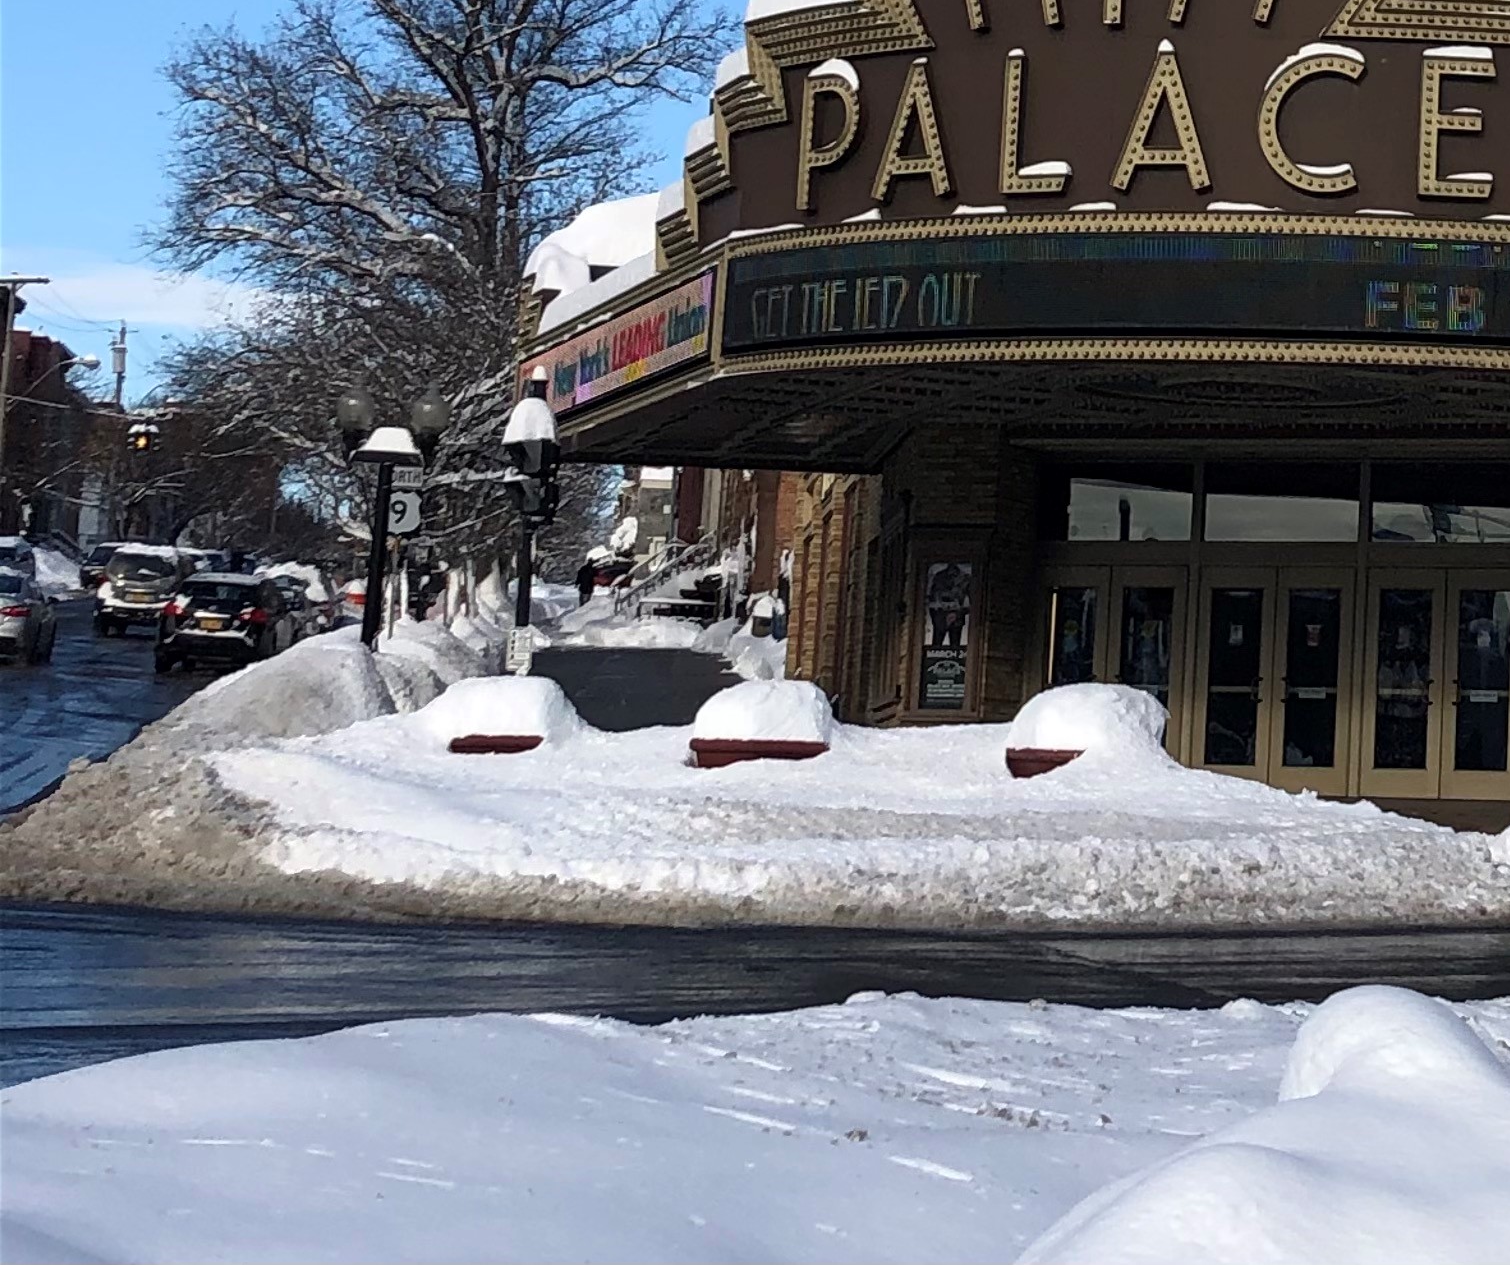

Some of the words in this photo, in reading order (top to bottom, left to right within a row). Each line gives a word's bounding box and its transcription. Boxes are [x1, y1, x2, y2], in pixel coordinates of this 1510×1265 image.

[797, 42, 1497, 210] PALACE
[802, 280, 848, 334] THE
[917, 272, 982, 327] OUT
[1365, 281, 1485, 331] FEB
[391, 499, 408, 524] 9
